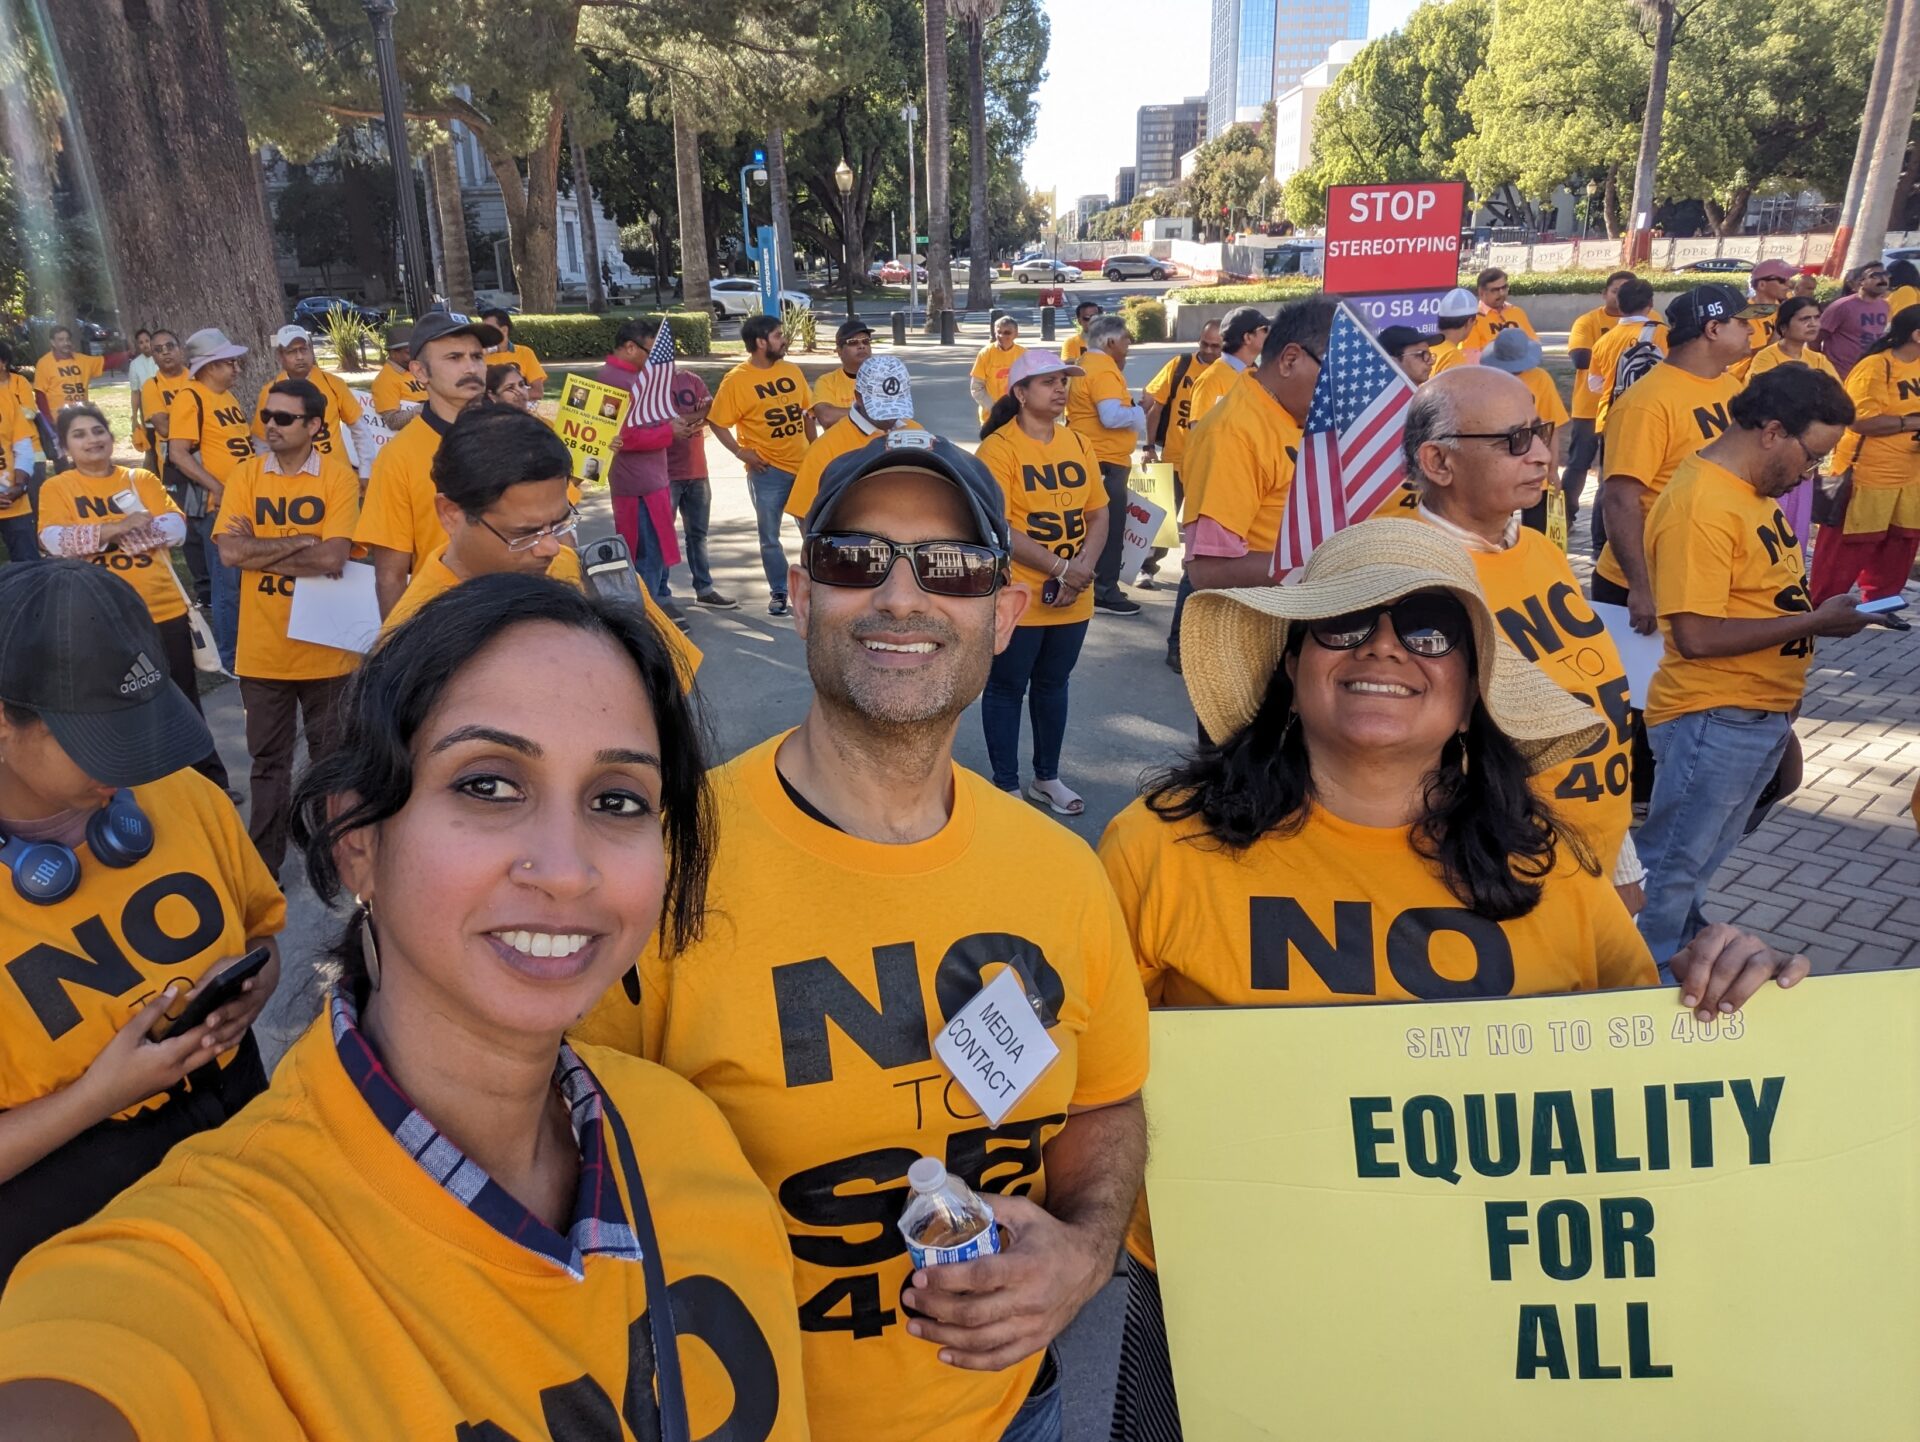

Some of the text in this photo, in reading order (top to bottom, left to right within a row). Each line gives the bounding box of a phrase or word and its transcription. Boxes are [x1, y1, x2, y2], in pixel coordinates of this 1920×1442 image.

[1349, 190, 1436, 223] STOP
[1328, 235, 1457, 257] STEREOTYPING
[1540, 252, 1564, 262] DPR
[1586, 249, 1611, 258] DPR
[1682, 247, 1708, 256] DPR
[1496, 255, 1519, 263] DPR
[1360, 298, 1441, 318] TO SB 40
[1707, 301, 1724, 317] 95
[1860, 313, 1887, 326] NO
[58, 365, 81, 377] NO
[62, 383, 85, 394] SB
[754, 377, 796, 399] NO
[1897, 378, 1920, 400] N
[214, 406, 246, 427] NO
[764, 403, 802, 427] SB
[1693, 403, 1732, 440] N
[563, 419, 597, 442] NO
[771, 421, 803, 438] 403
[564, 437, 600, 456] SB 403
[1022, 461, 1086, 491] NO
[1129, 479, 1156, 493] EQUALITY
[256, 496, 325, 525] NO
[1050, 492, 1072, 507] TO
[1757, 508, 1798, 566] NO
[258, 575, 296, 597] 40
[1496, 581, 1605, 663] NO
[1556, 647, 1605, 681] TO
[120, 669, 161, 694] adidas
[1554, 753, 1631, 803] 40
[119, 815, 144, 836] JBL
[31, 856, 62, 886] JBL
[5, 871, 225, 1042] NO
[1249, 895, 1515, 999] NO
[771, 932, 1065, 1088] NO
[979, 1002, 1025, 1064] MEDIA
[1406, 1008, 1746, 1059] SAY NO TO SB 403
[947, 1017, 1016, 1100] CONTACT
[1349, 1075, 1786, 1185] EQUALITY
[1484, 1196, 1656, 1281] FOR
[1515, 1302, 1673, 1380] ALL
